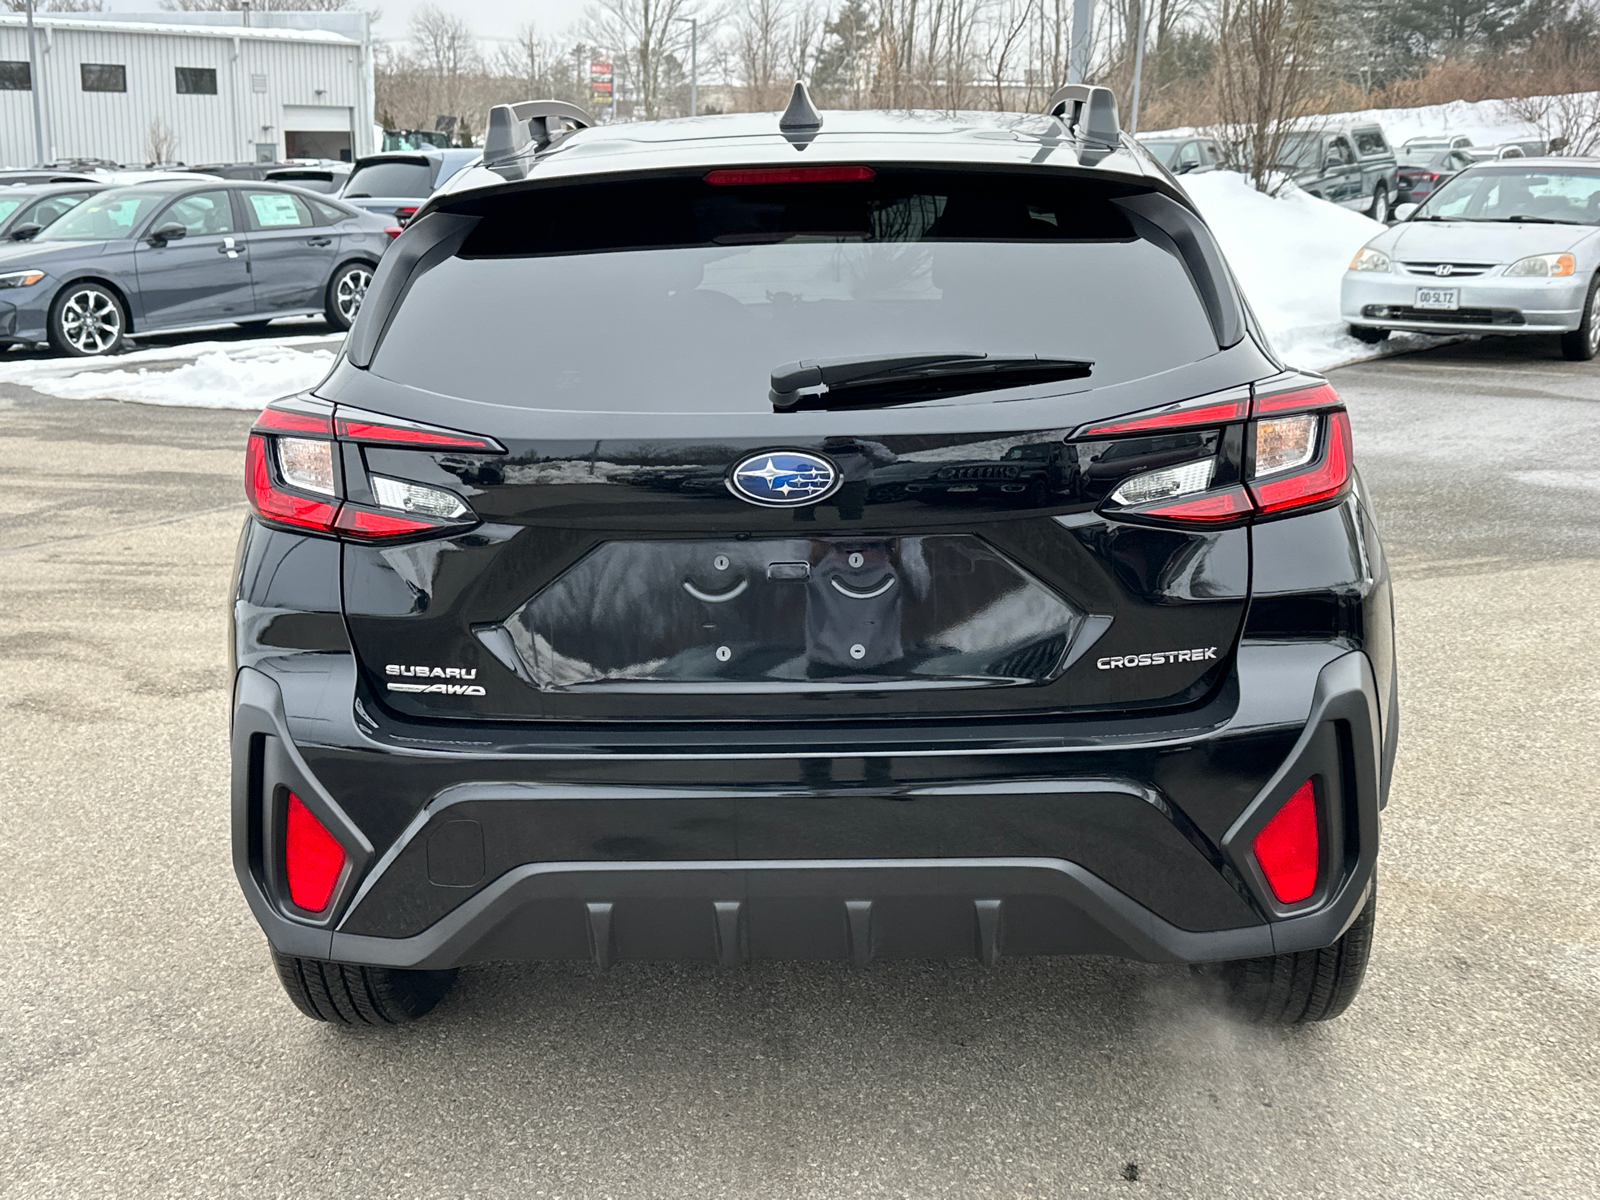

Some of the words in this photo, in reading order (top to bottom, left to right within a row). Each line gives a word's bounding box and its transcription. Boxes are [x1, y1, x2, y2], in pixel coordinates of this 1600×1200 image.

[1096, 646, 1218, 670] CROSSTREK
[385, 664, 477, 680] SUBARU
[423, 683, 486, 696] AWD
